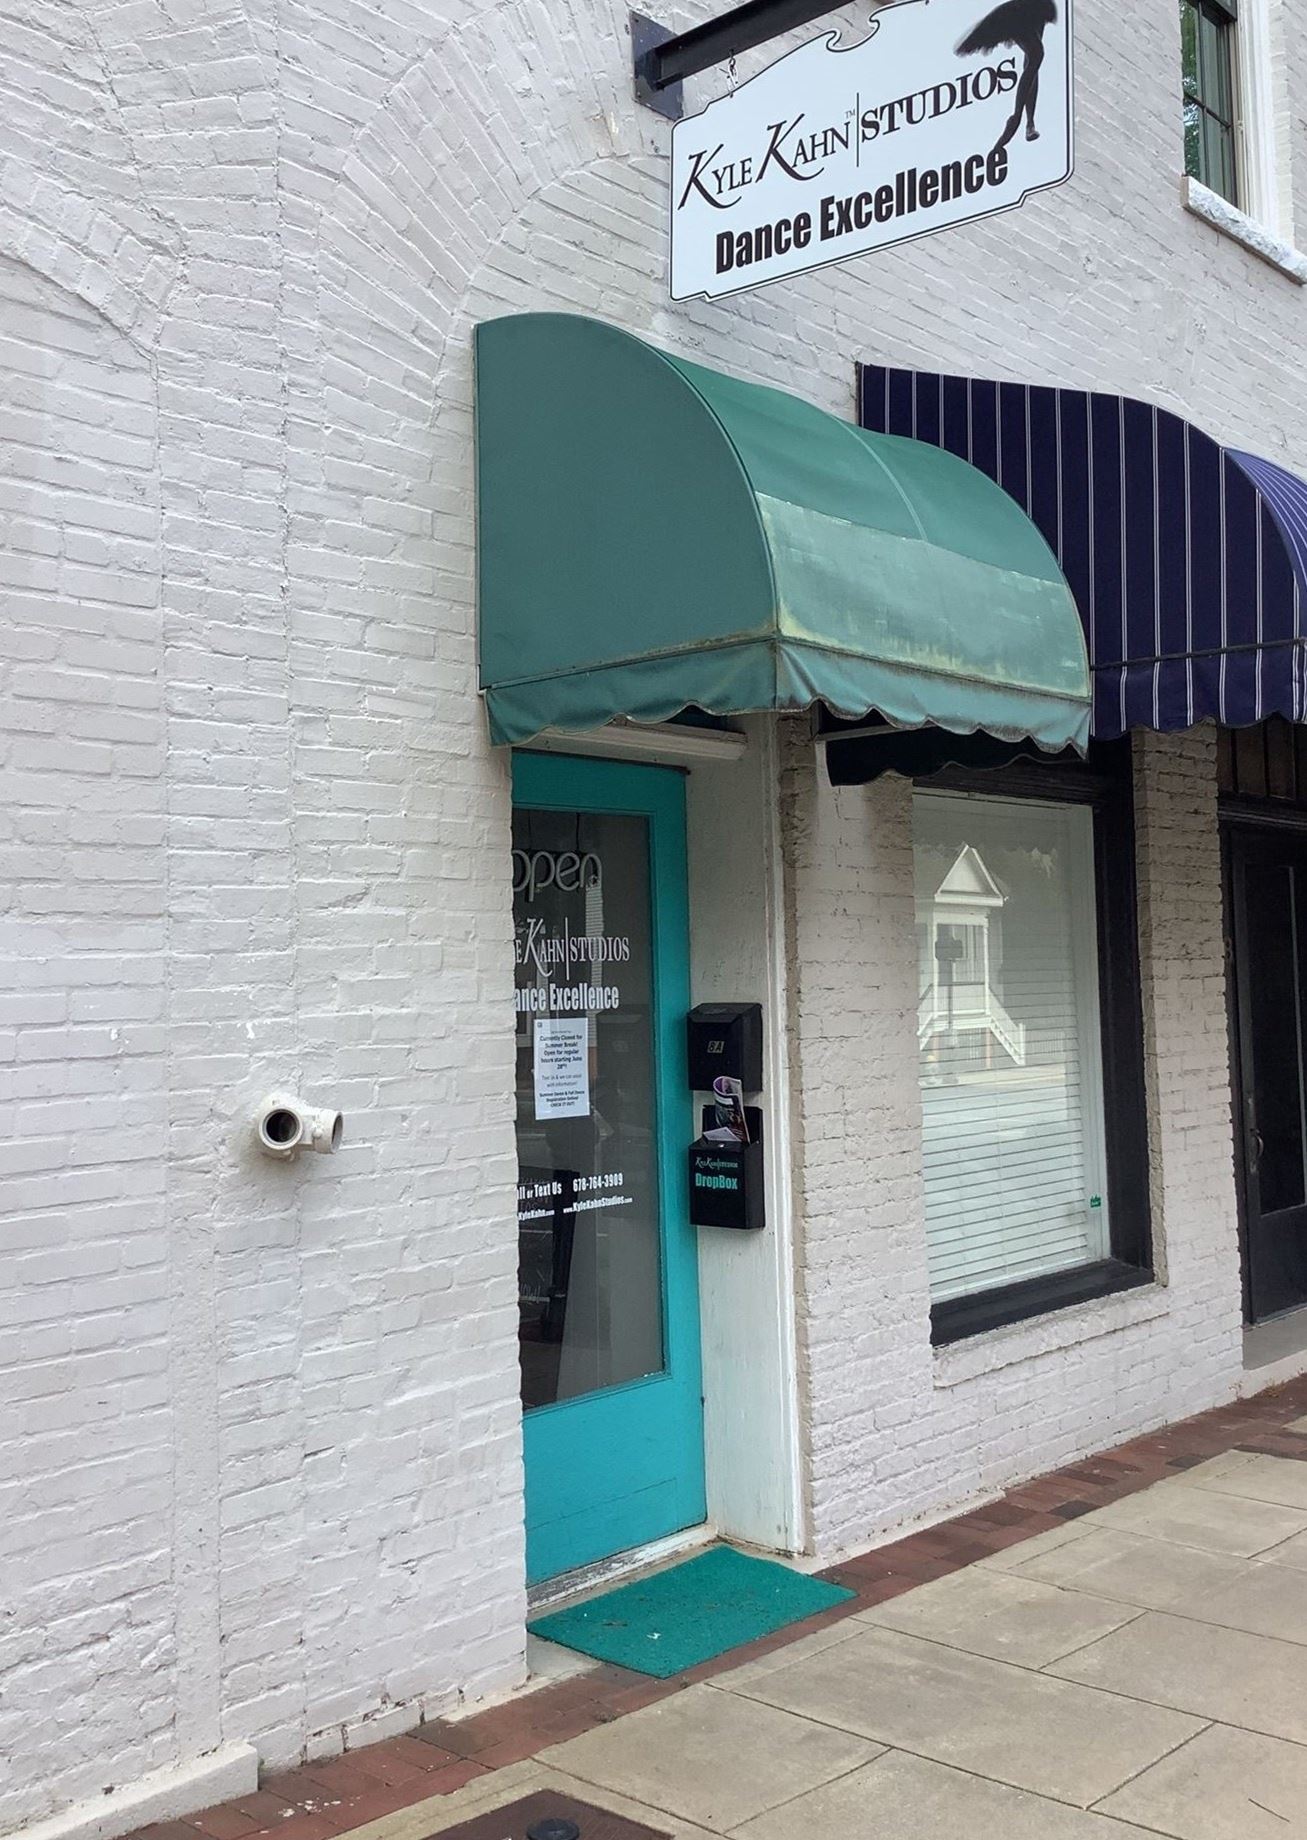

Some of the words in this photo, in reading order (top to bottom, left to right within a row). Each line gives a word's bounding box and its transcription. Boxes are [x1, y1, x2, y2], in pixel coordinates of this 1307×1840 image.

[677, 144, 752, 210] KYLE
[755, 113, 850, 184] KAHN
[861, 57, 1018, 143] STUDIOS
[715, 211, 811, 274] Dance
[820, 146, 1008, 241] Excellence
[570, 937, 631, 962] STUDIOS
[514, 986, 546, 1011] ance
[550, 983, 620, 1011] Excellence
[517, 1186, 525, 1200] ll
[527, 1190, 533, 1199] or
[534, 1183, 551, 1197] Text
[552, 1181, 562, 1195] Us
[695, 1172, 738, 1190] DropBox
